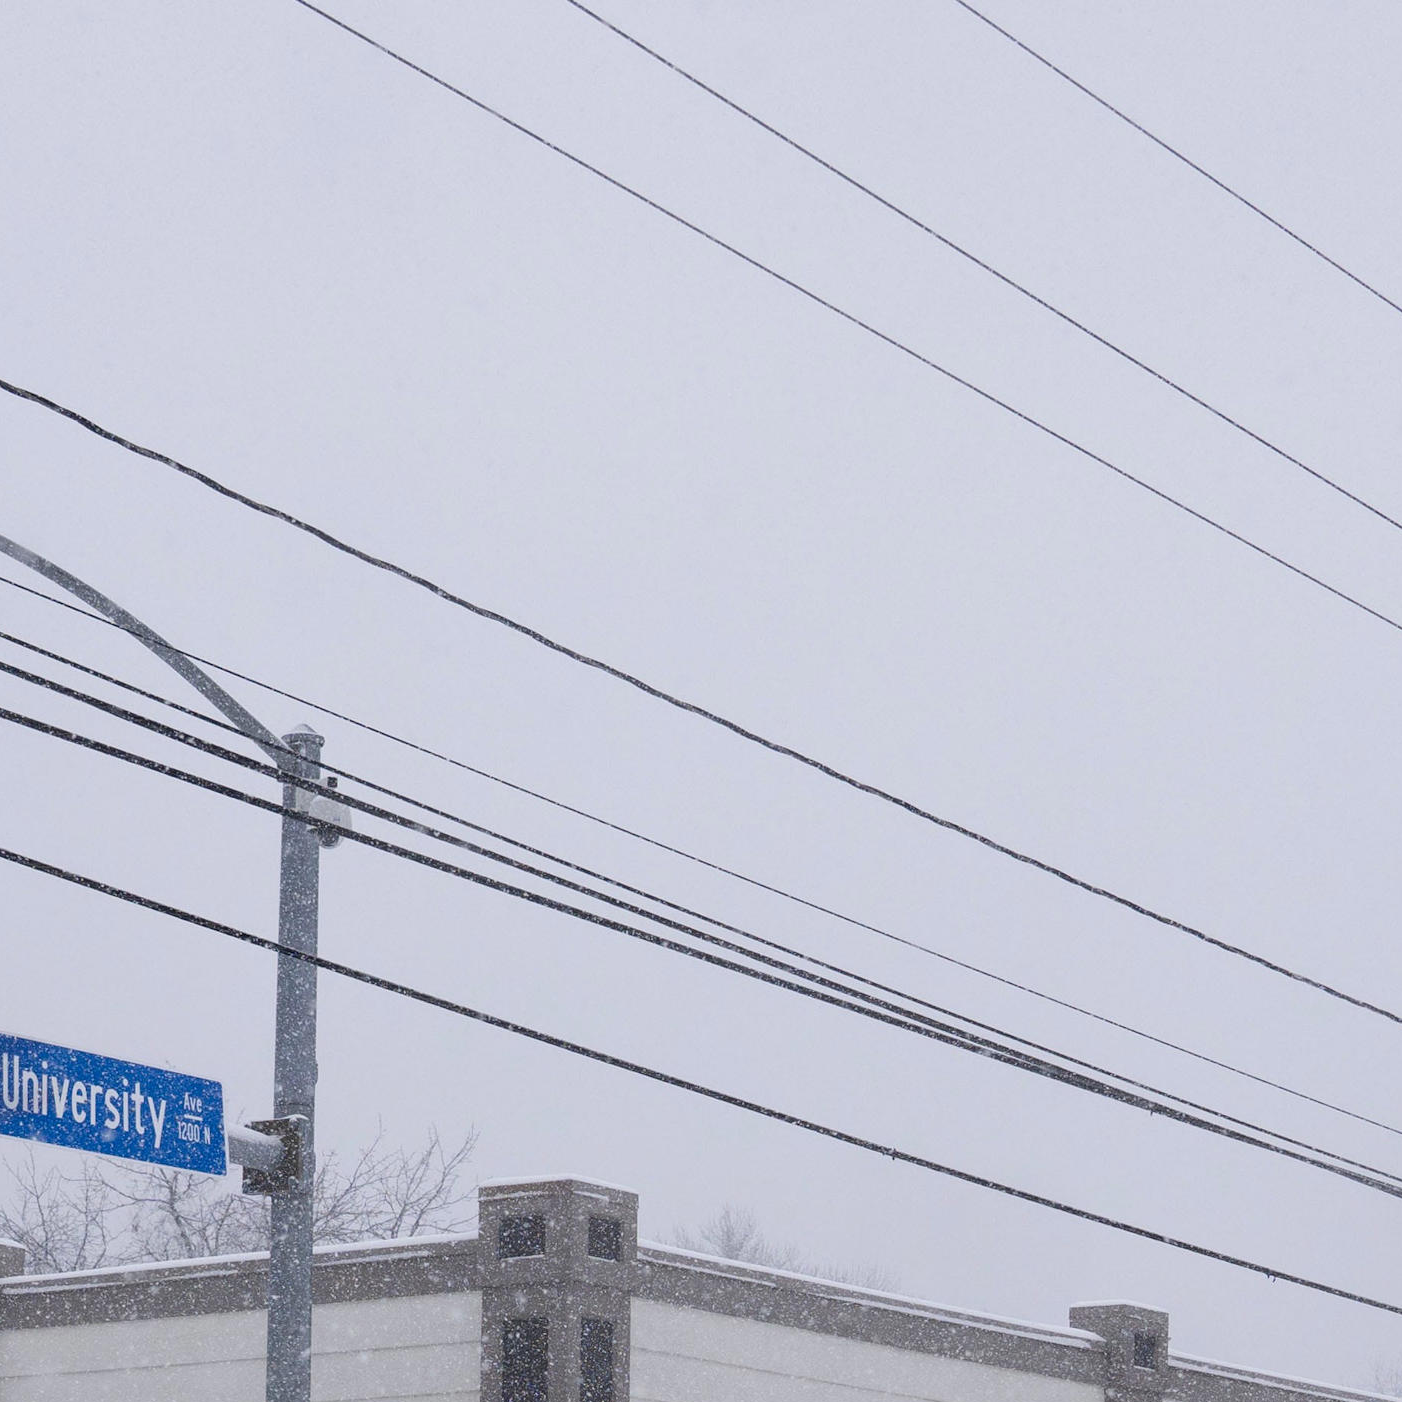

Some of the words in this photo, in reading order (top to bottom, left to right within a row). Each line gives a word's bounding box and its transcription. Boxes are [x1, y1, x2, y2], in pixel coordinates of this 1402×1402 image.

[1, 1052, 167, 1149] University
[183, 1091, 203, 1113] Ave
[177, 1121, 200, 1143] 1200
[204, 1125, 211, 1145] N
